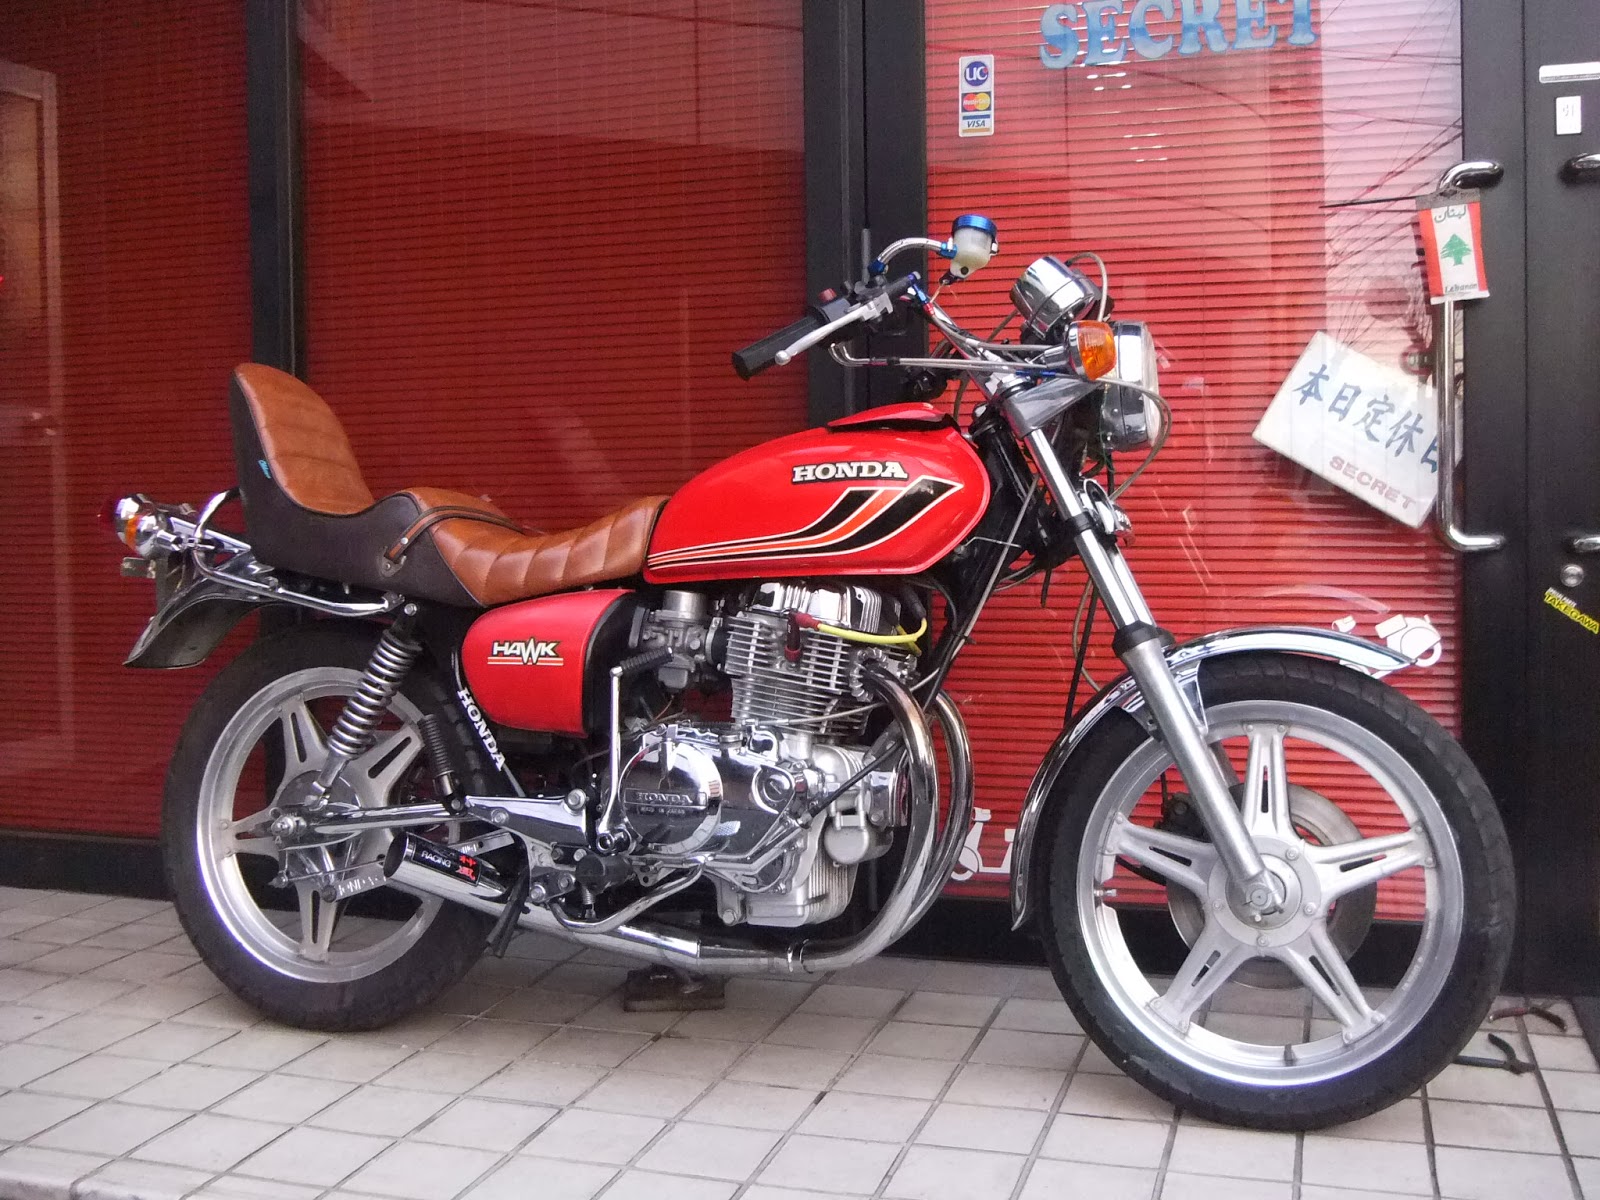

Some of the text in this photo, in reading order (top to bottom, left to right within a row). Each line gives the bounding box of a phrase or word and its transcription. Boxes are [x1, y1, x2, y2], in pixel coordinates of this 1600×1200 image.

[1039, 0, 1320, 69] SECRET
[967, 119, 986, 128] VISA
[792, 460, 909, 483] HONDA
[1329, 455, 1416, 509] SECRET
[492, 636, 560, 665] HAWK
[457, 687, 506, 771] HONDA
[636, 791, 693, 804] HONDA
[420, 850, 451, 868] RACING
